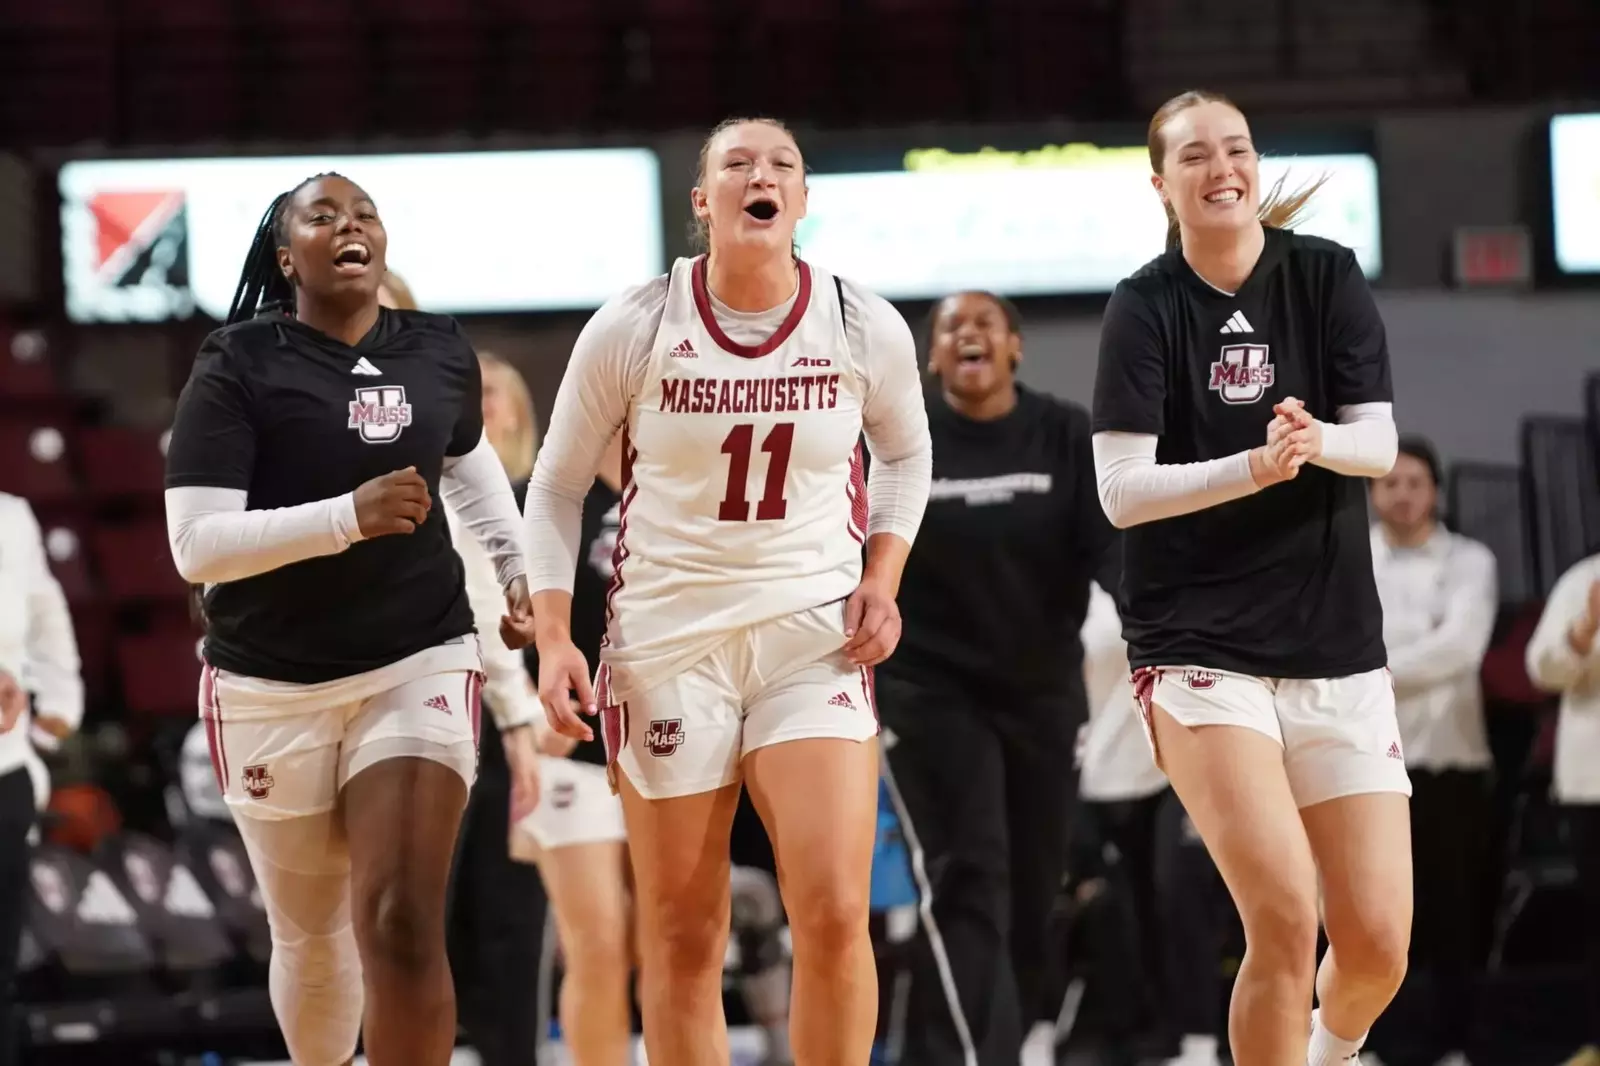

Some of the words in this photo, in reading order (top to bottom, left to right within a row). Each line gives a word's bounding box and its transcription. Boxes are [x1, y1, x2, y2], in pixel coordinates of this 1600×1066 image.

[669, 350, 699, 359] adidas
[659, 374, 840, 414] MASSACHUSETTS
[718, 422, 796, 522] 11
